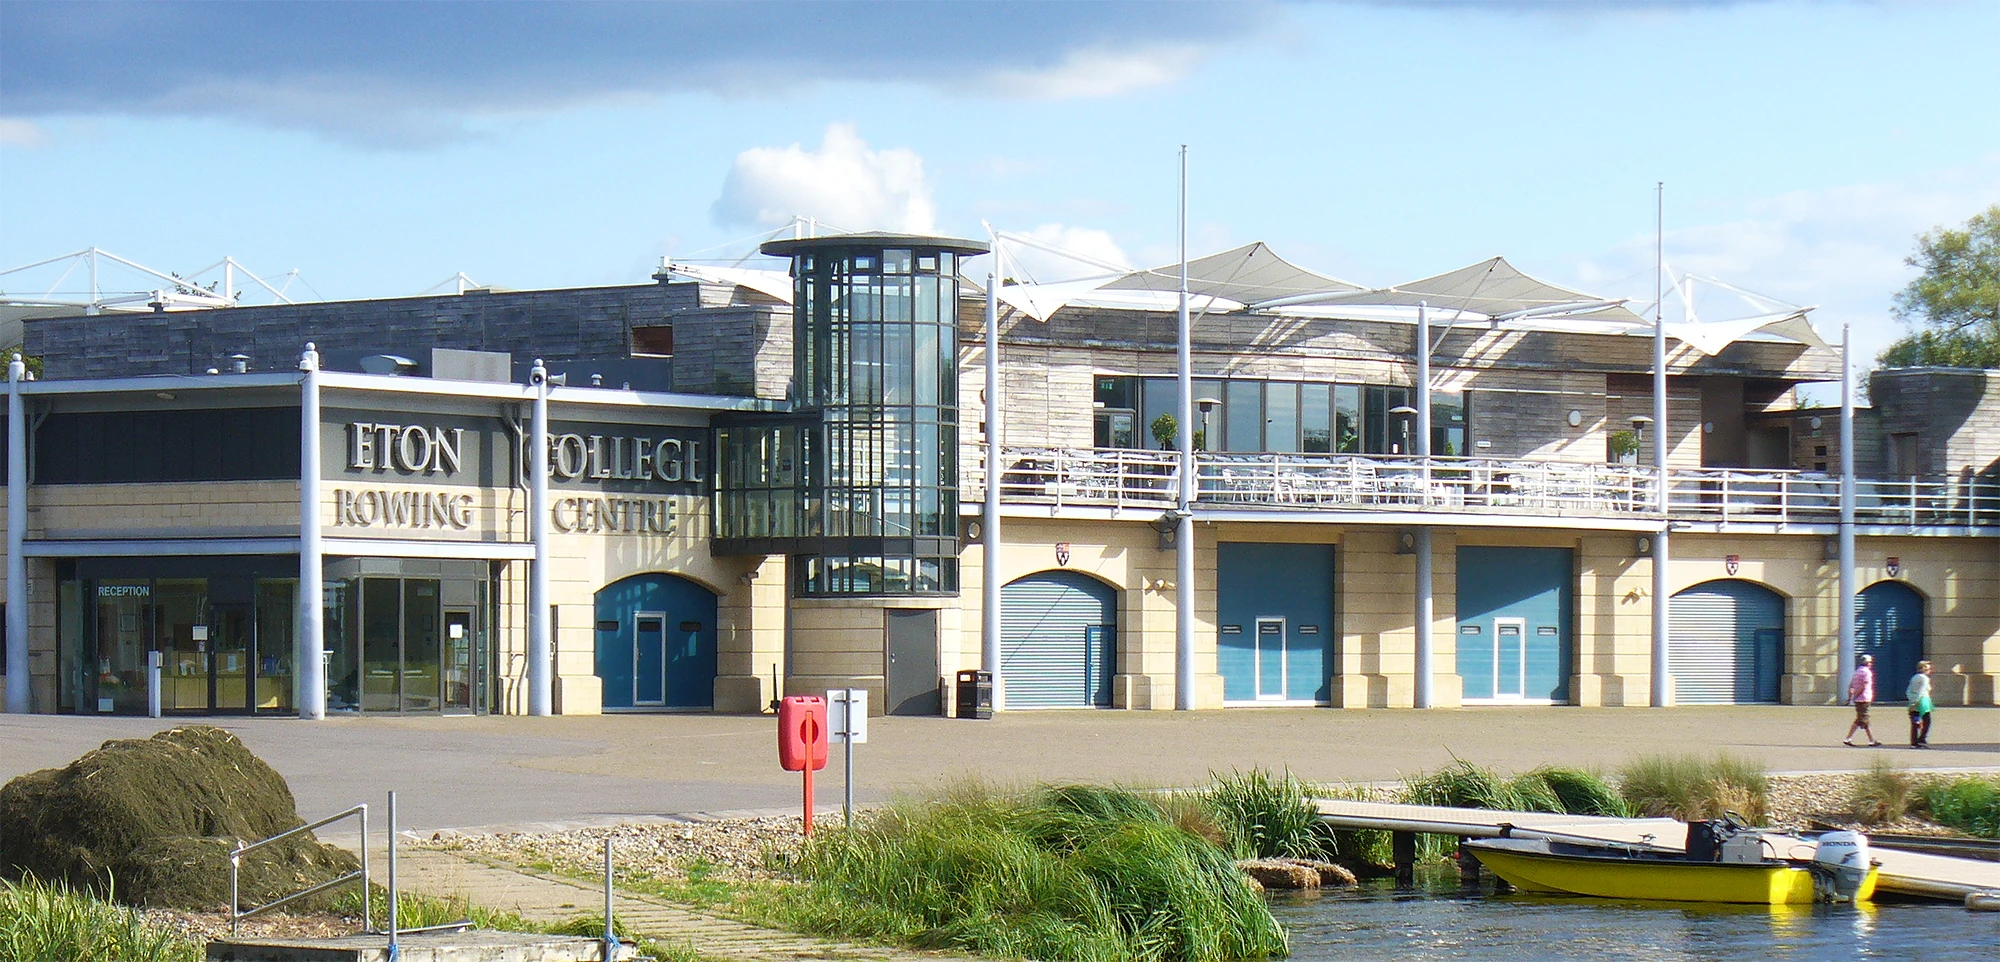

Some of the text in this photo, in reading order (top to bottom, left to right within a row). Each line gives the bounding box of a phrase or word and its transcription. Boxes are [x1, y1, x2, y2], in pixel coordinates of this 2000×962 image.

[353, 422, 464, 472] ETON
[336, 489, 677, 533] ROWING CENTRE
[98, 586, 150, 597] RECEPTION
